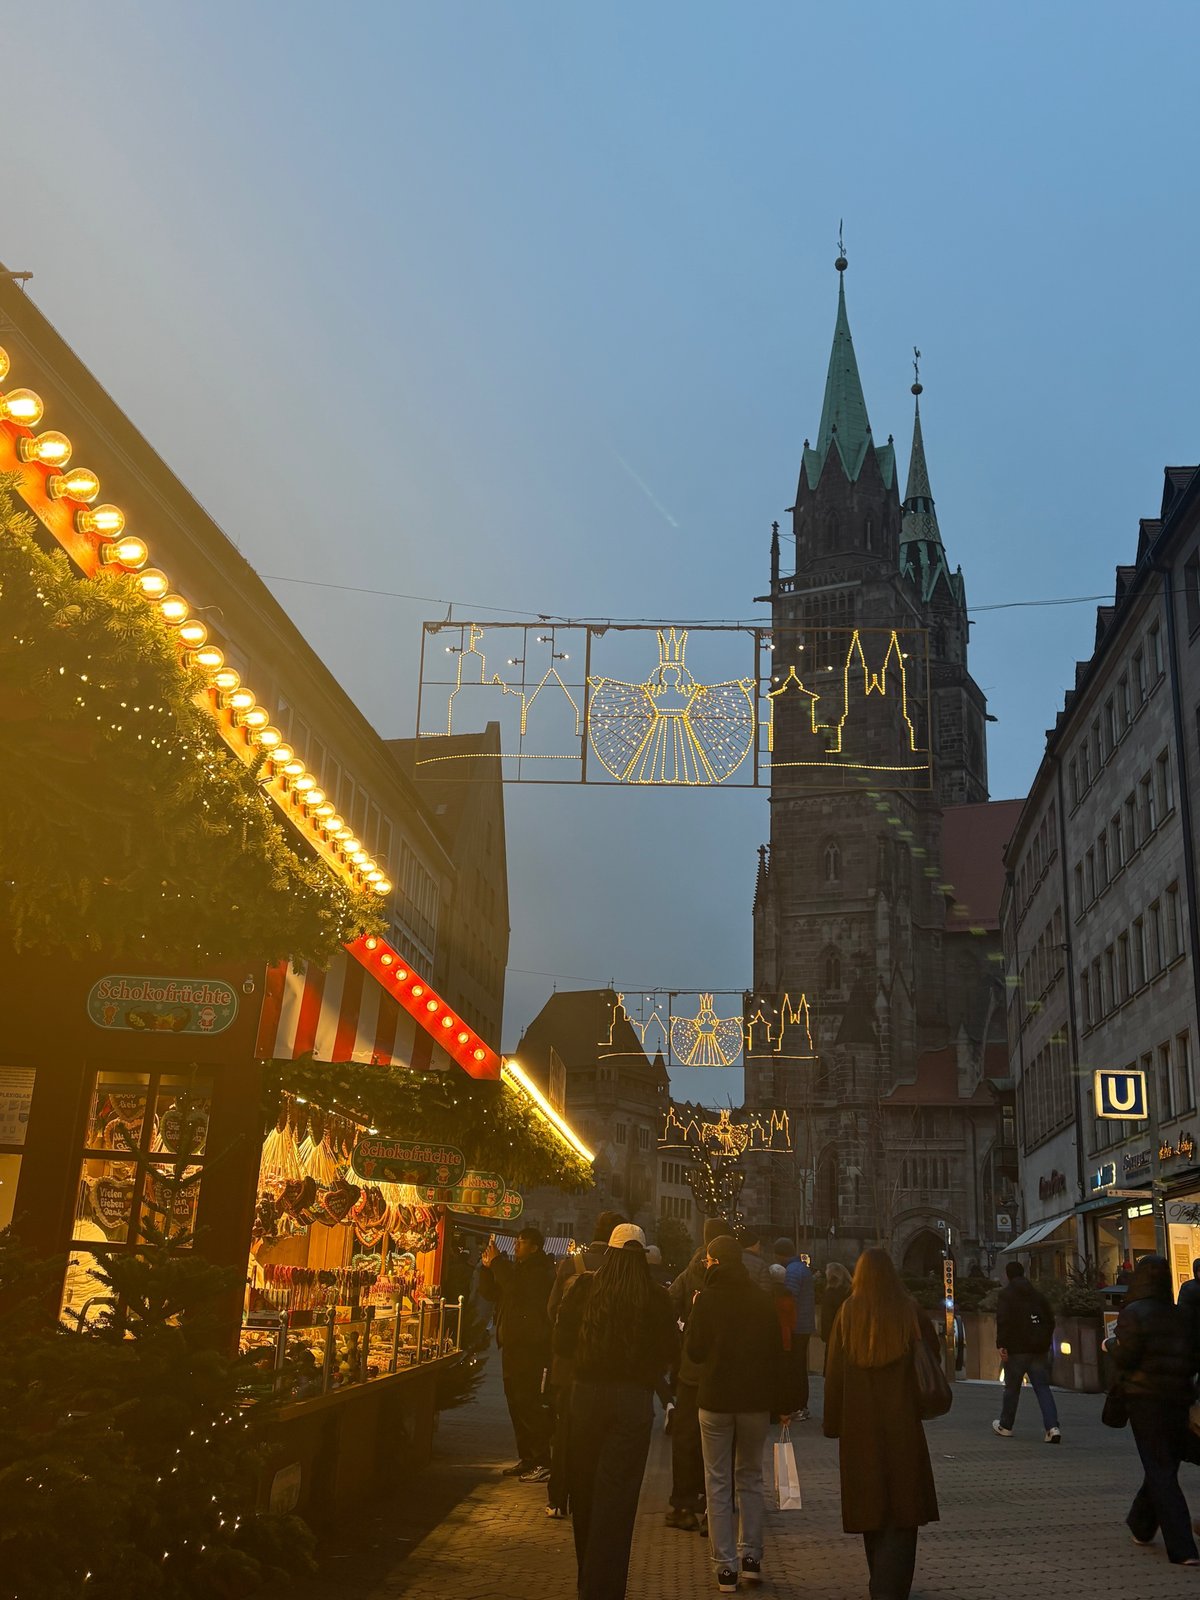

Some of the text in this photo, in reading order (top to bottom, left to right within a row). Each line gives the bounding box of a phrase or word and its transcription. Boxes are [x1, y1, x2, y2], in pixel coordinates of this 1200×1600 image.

[98, 980, 232, 1006] Schokofrüchte
[1108, 1078, 1136, 1111] U
[360, 1142, 461, 1166] Schokofrüchte
